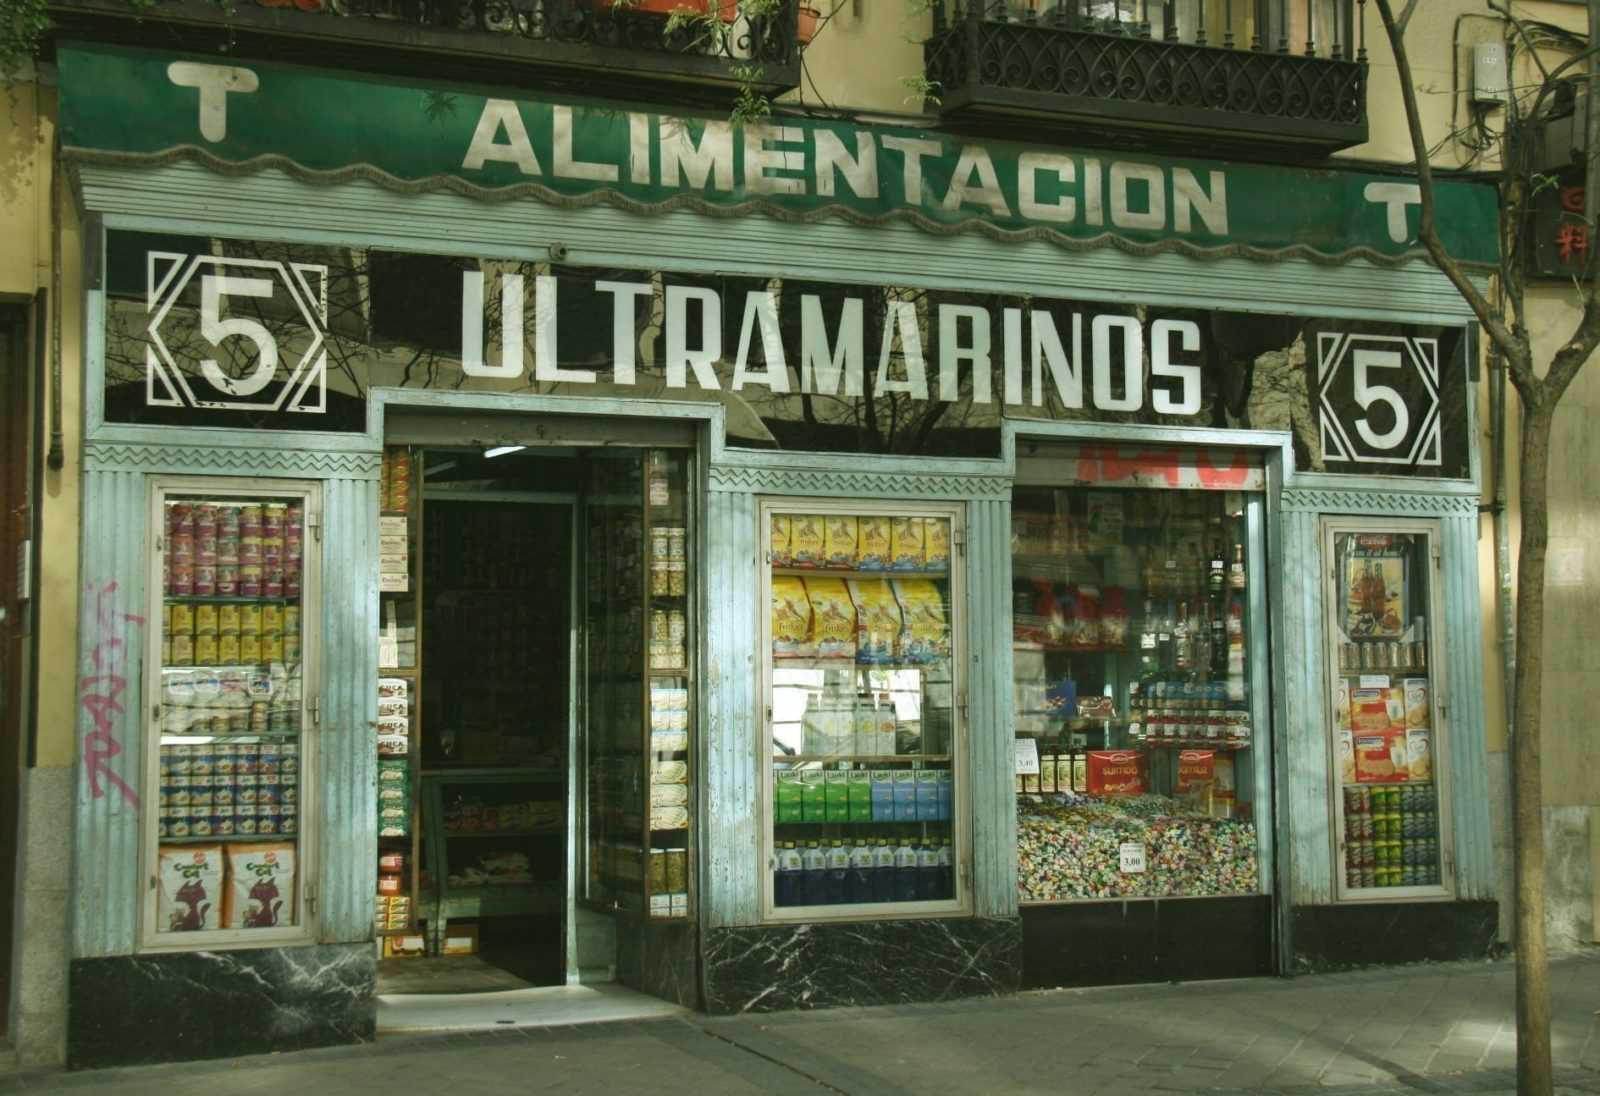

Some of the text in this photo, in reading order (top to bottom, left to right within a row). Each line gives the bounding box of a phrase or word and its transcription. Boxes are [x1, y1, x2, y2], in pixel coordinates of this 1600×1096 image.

[167, 61, 259, 142] T
[462, 98, 1229, 236] ALIMENTACION
[1364, 182, 1422, 244] T
[200, 275, 278, 396] 5
[462, 270, 1200, 416] ULTRAMARINOS
[1353, 350, 1409, 450] 5
